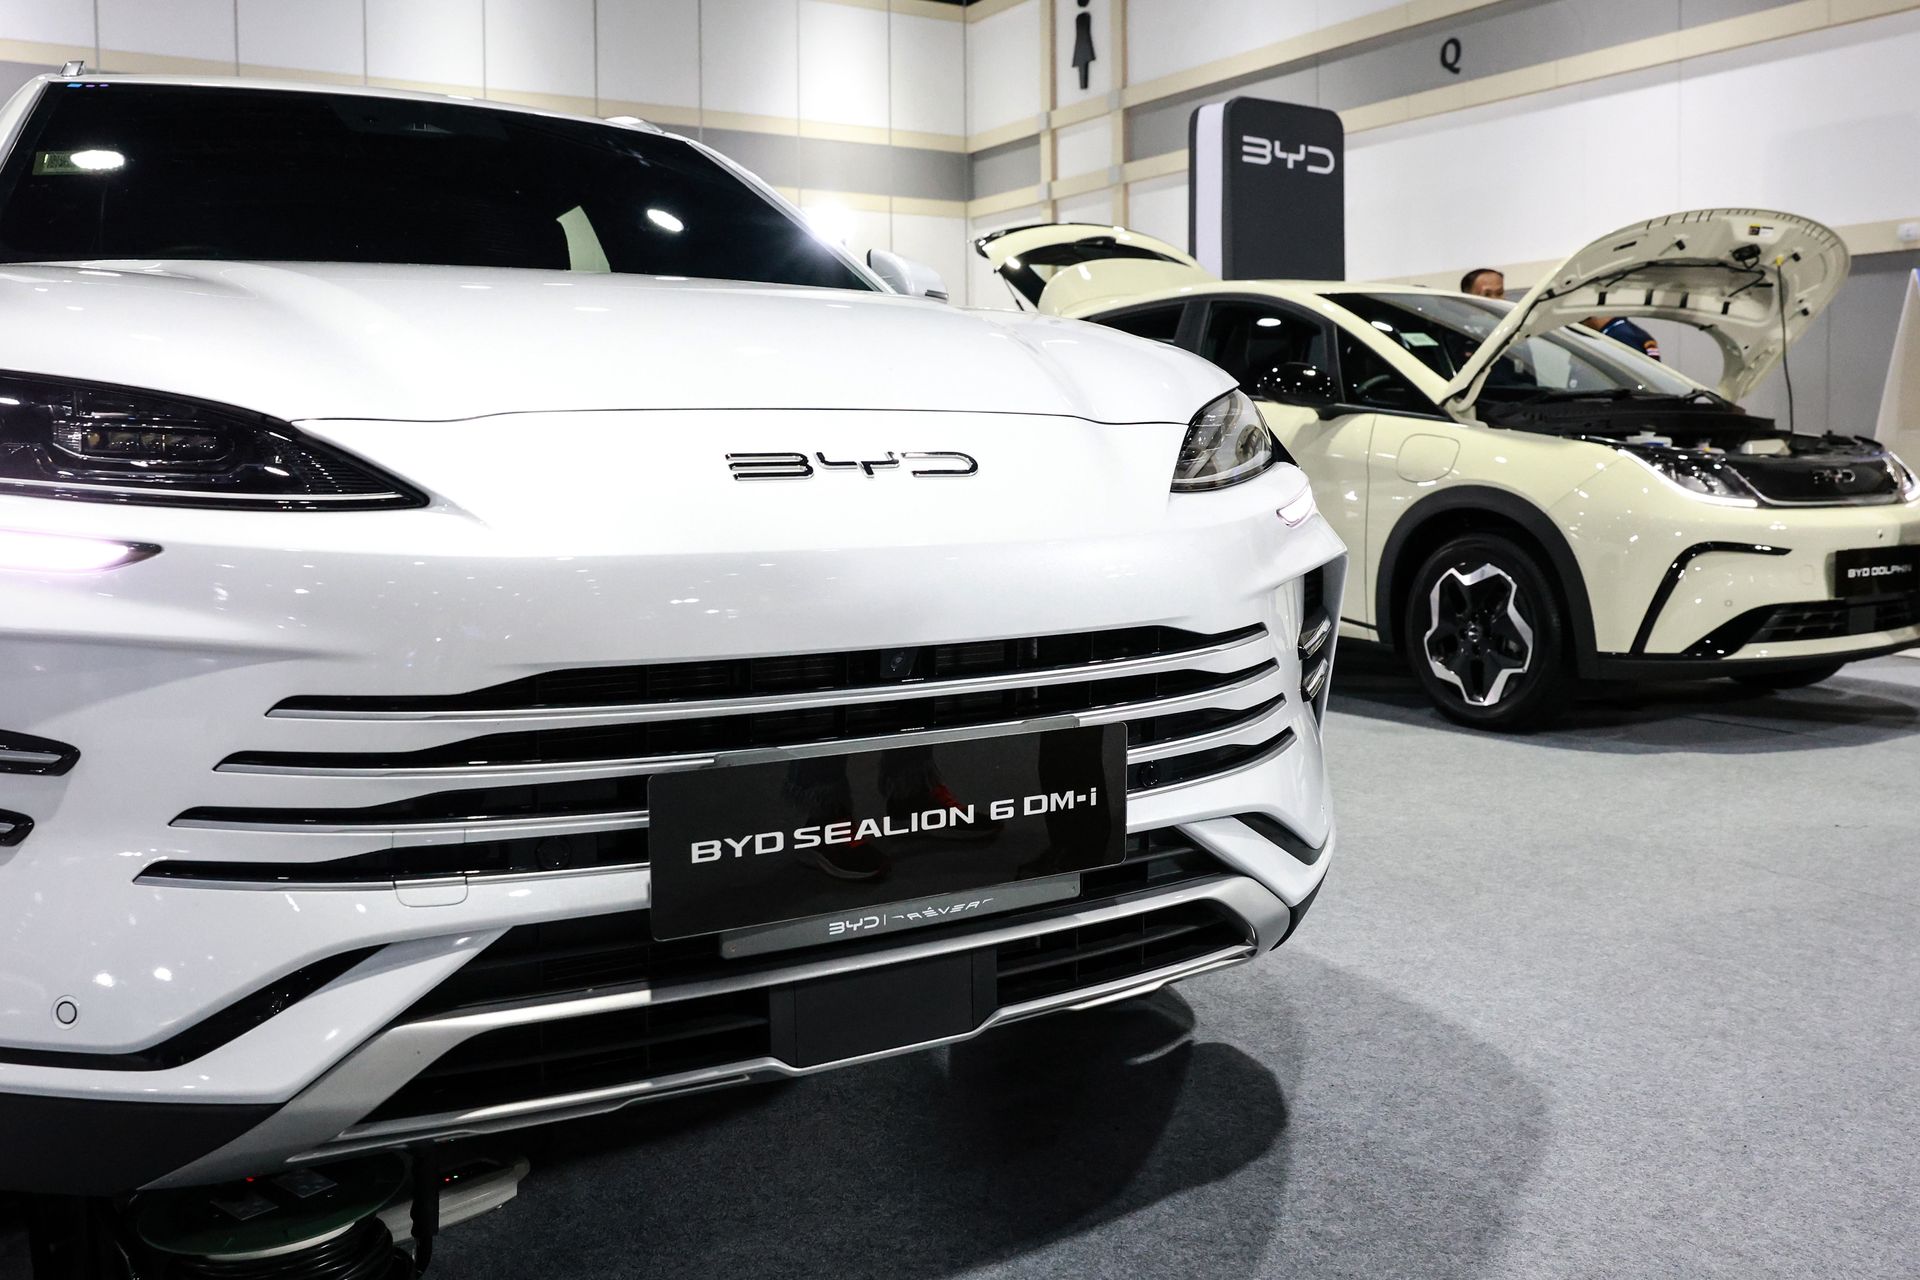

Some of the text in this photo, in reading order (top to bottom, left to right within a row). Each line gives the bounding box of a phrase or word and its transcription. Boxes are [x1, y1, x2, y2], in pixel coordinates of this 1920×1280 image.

[1440, 37, 1462, 75] Q
[1241, 135, 1335, 175] BYD
[725, 451, 979, 480] BYD
[1847, 567, 1870, 578] BYD
[691, 787, 1097, 864] BYD SEALION 6 DM-i
[829, 916, 880, 936] BYD
